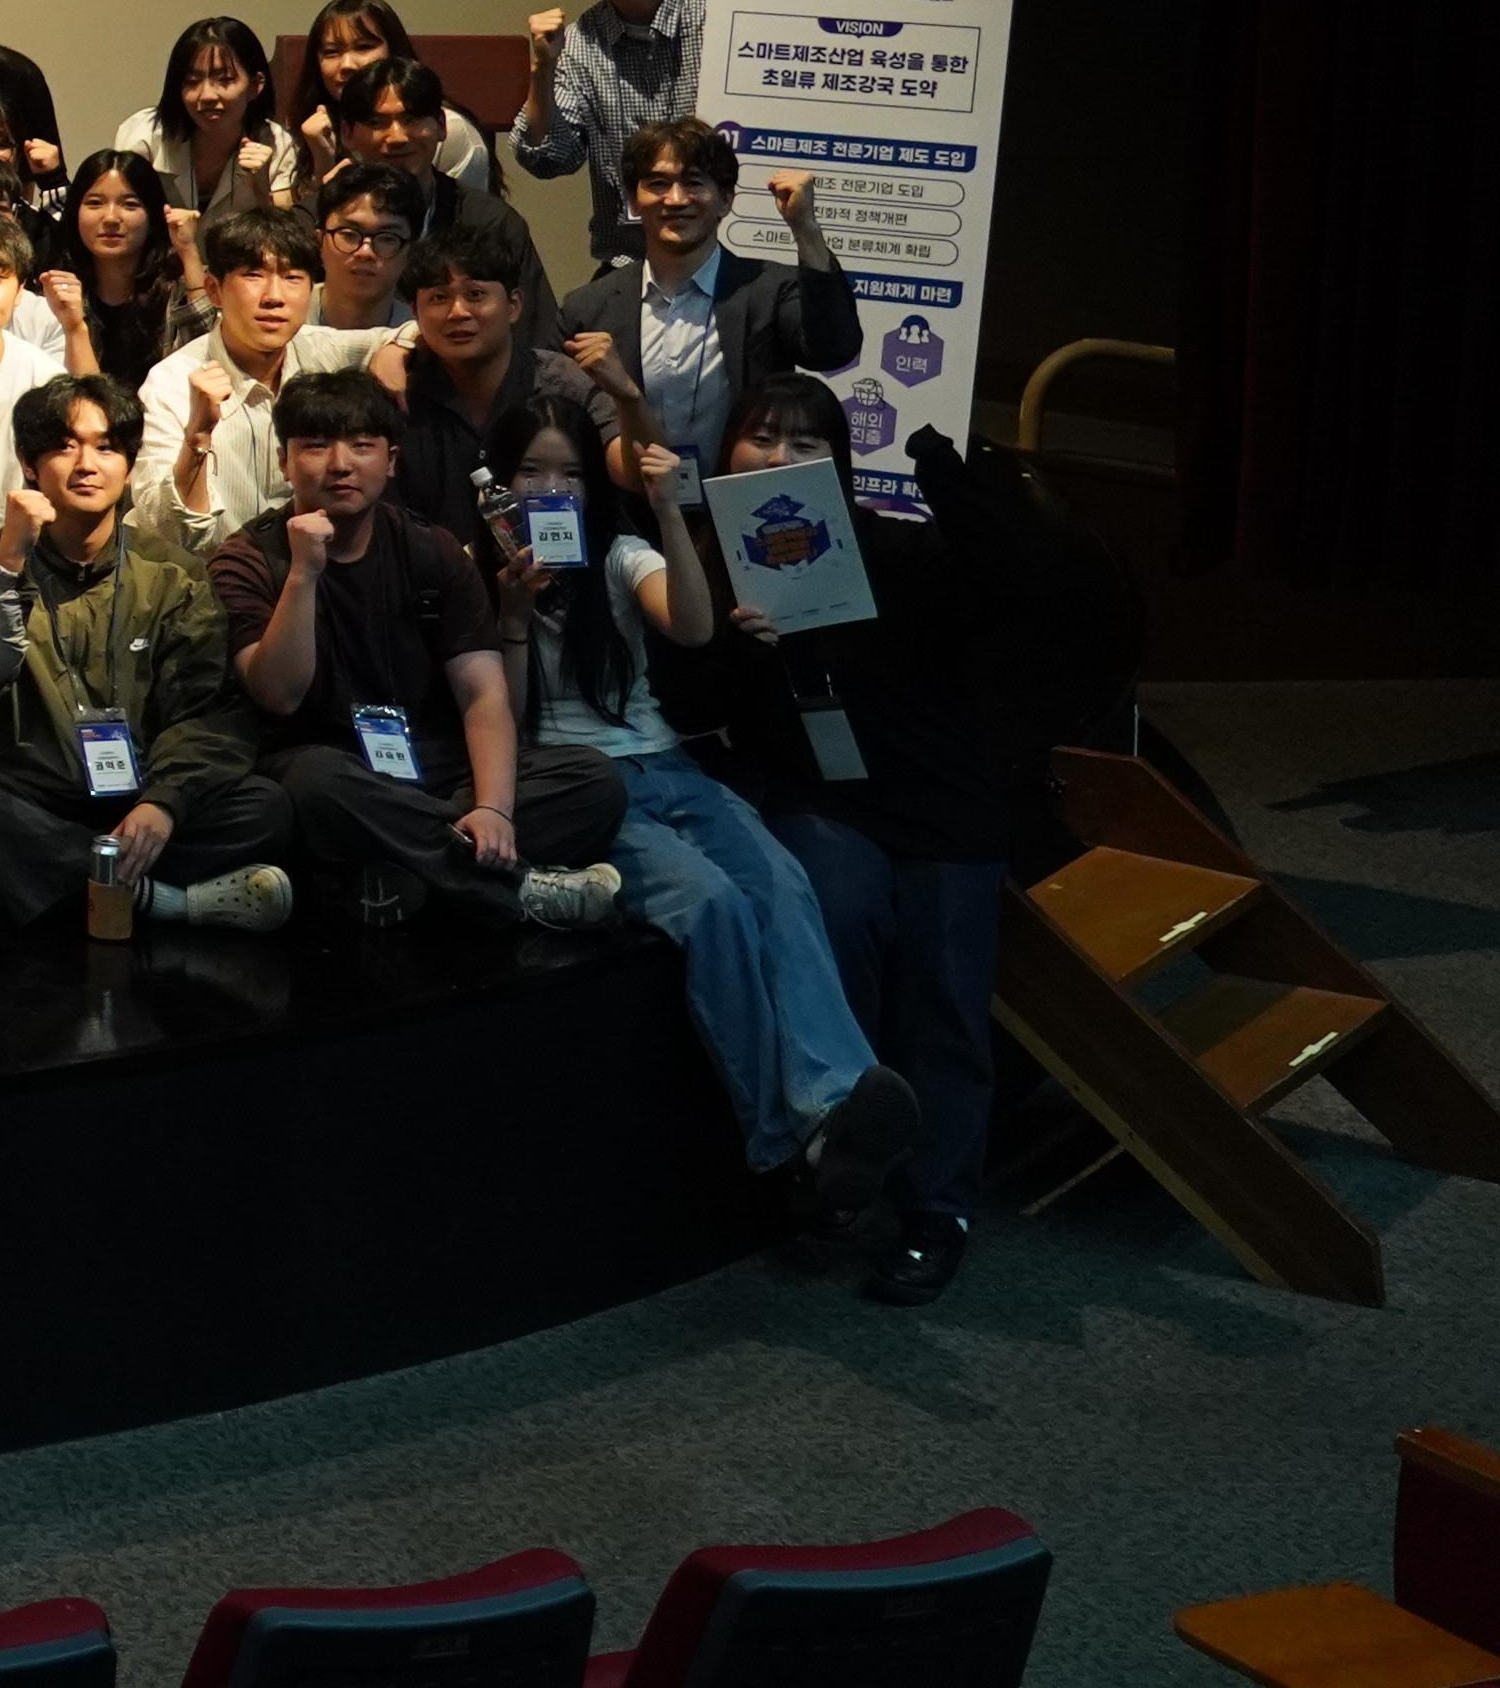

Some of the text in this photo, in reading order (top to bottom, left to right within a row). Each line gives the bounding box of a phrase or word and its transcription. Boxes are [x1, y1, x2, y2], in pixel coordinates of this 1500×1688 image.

[836, 20, 884, 35] VISION
[738, 42, 969, 74] 스마트제조산업 육성을 통한
[762, 70, 937, 98] 초일류 제조강국 도약
[751, 135, 966, 168] 스마트제조 전문기업 제도 도입
[840, 179, 894, 196] 전문기업
[898, 183, 924, 199] 도입
[848, 240, 900, 256] 분류체계
[853, 279, 952, 304] 지원체계 마련
[895, 354, 927, 374] 인력
[851, 412, 883, 428] 해외
[852, 430, 880, 446] 진출
[853, 476, 898, 495] 인프라
